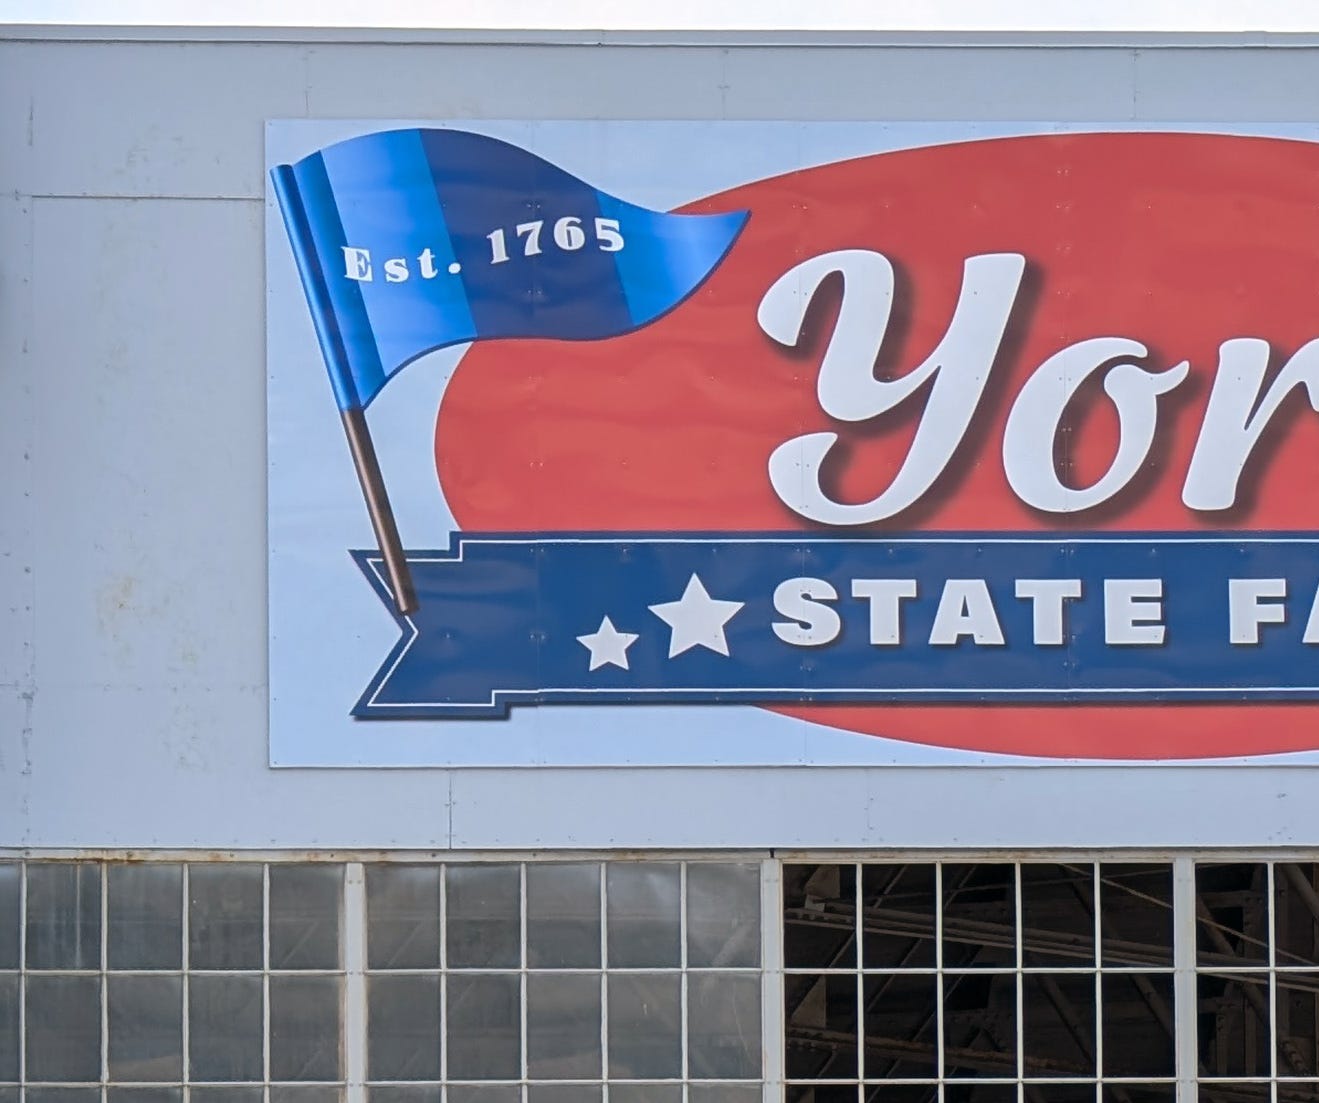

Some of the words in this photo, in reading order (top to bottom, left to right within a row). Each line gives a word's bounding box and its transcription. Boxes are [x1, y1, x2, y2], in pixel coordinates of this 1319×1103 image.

[344, 246, 462, 283] Est.
[487, 216, 625, 265] 1765
[770, 577, 1167, 646] STATE
